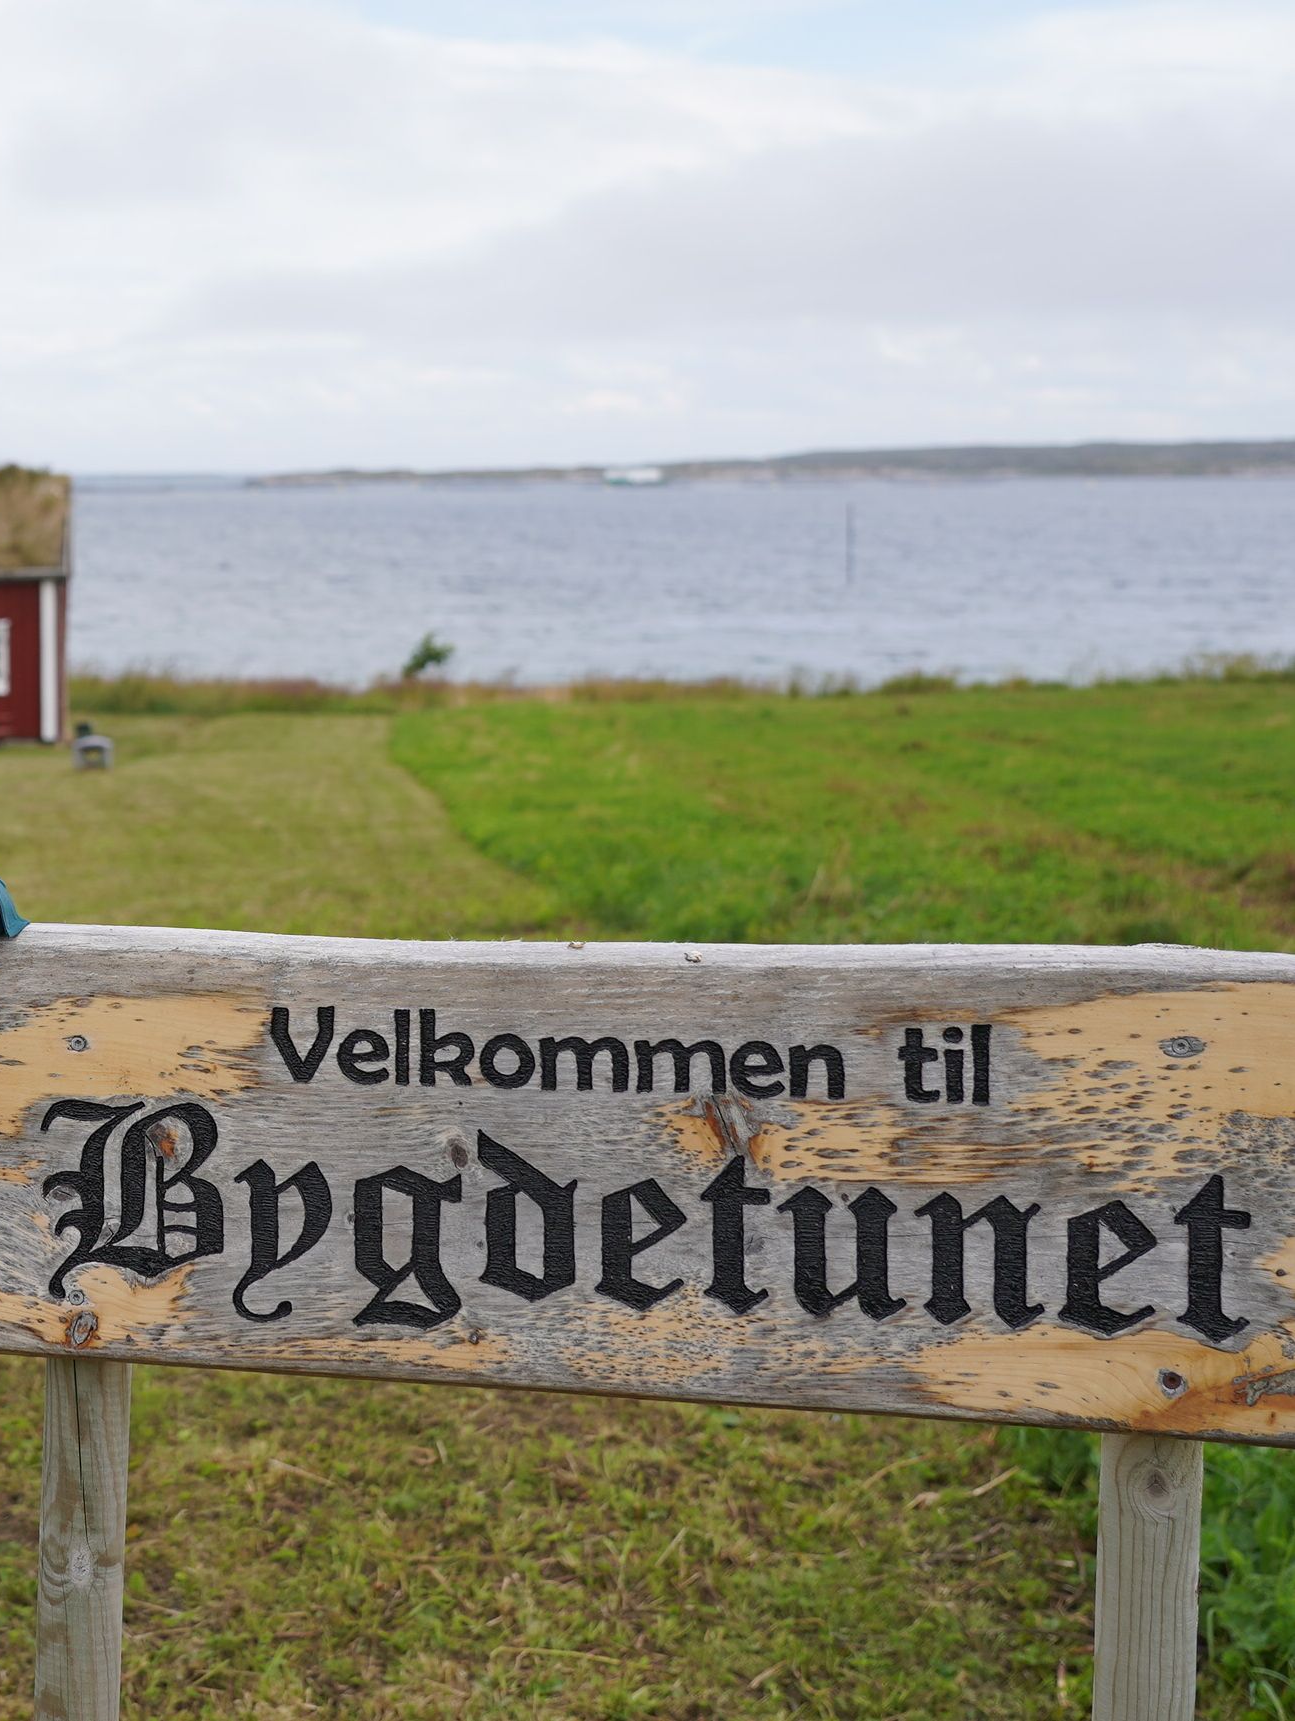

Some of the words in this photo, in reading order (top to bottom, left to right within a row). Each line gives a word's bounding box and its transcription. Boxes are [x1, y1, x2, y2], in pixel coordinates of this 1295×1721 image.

[270, 1005, 845, 1100] Velkommen
[898, 1023, 992, 1105] til
[40, 1100, 1252, 1343] Bygdetunet
